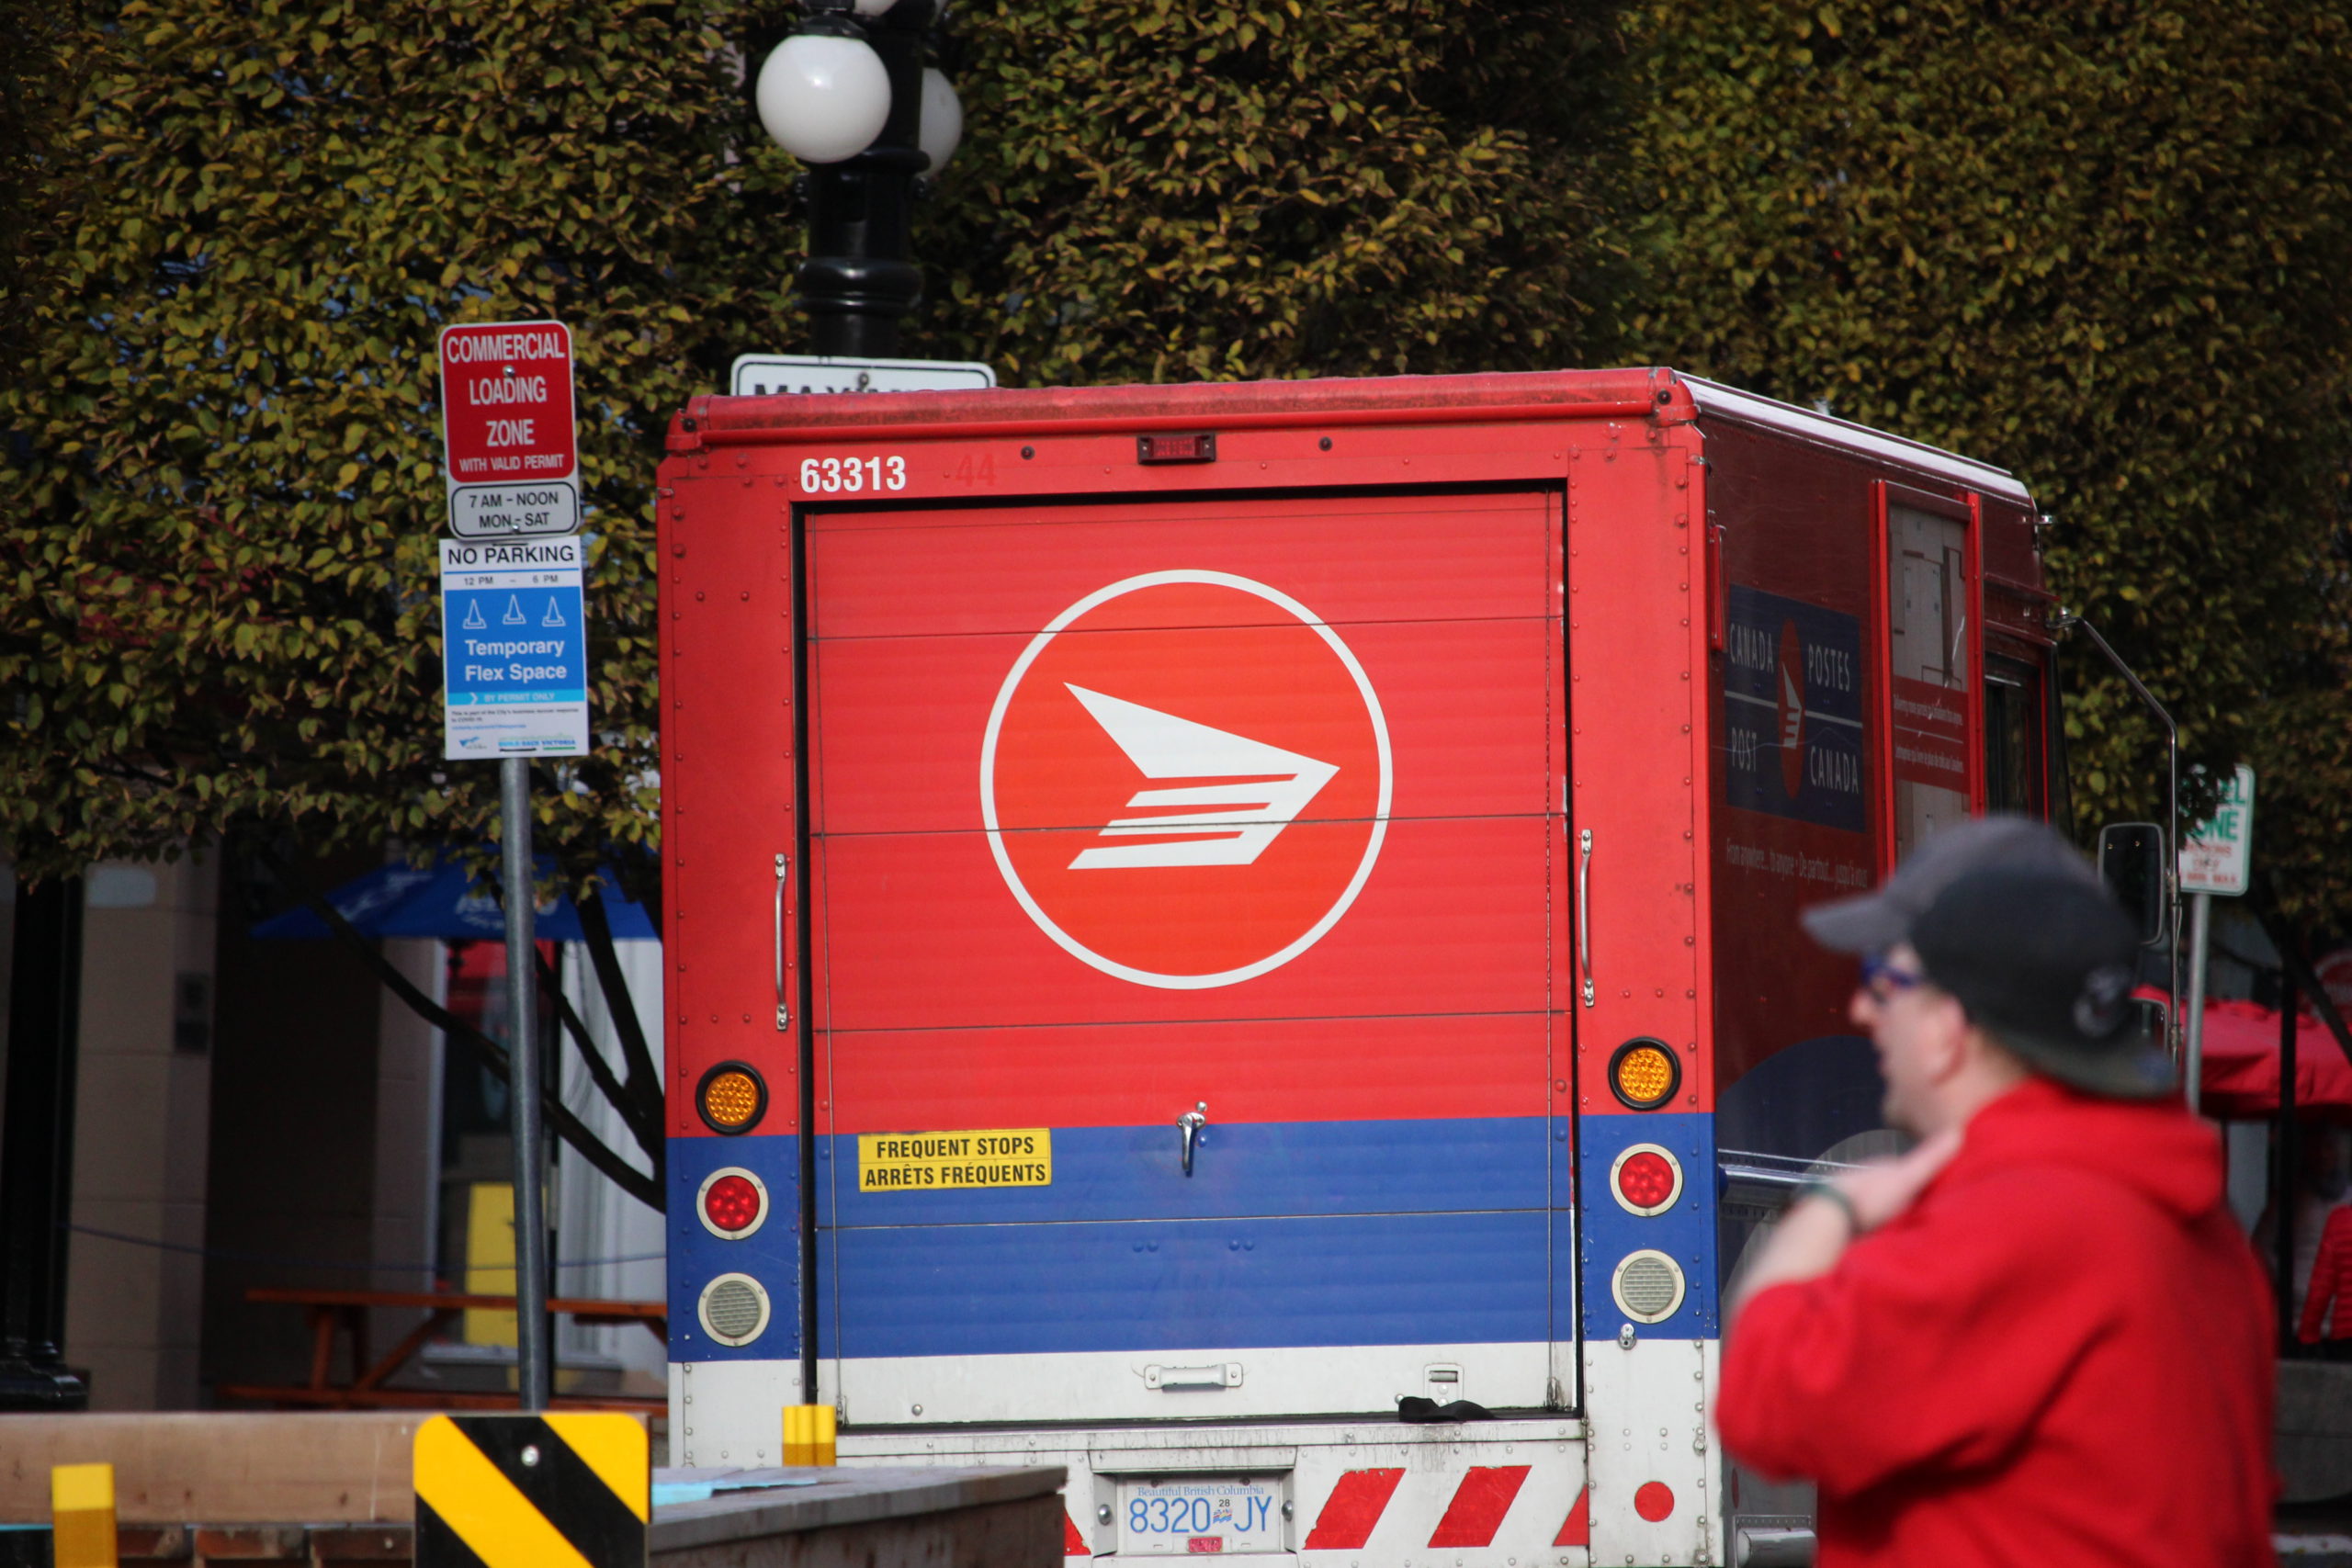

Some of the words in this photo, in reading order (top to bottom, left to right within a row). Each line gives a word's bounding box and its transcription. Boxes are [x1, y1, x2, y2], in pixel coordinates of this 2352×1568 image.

[447, 333, 565, 364] COMMERCIAL
[469, 376, 547, 405] LOADING
[486, 419, 536, 447] ZONE
[459, 457, 488, 472] WITH
[490, 456, 521, 470] VALID
[524, 454, 564, 469] PERMIT
[800, 456, 907, 493] 63313
[469, 494, 478, 508] 7
[481, 494, 503, 507] AM
[516, 491, 559, 506] NOON
[479, 514, 512, 528] MON
[525, 513, 550, 526] SAT
[447, 547, 477, 565] NO
[484, 545, 574, 564] PARKING
[464, 577, 475, 586] 12
[478, 576, 494, 585] PM
[532, 575, 539, 584] 6
[543, 574, 559, 583] PM
[464, 638, 565, 659] Temporary
[1729, 623, 1774, 673] CANADA
[465, 665, 504, 682] Flex
[509, 662, 567, 683] Space
[1808, 644, 1850, 693] POSTES
[1731, 727, 1758, 772] POST
[1810, 746, 1859, 795] CANADA
[876, 1138, 970, 1158] FREQUENT
[977, 1136, 1035, 1156] STOPS
[865, 1164, 934, 1187] ARRÊTS
[941, 1161, 1046, 1185] FRÉQUENTS
[1137, 1485, 1182, 1497] Beautiful
[1183, 1484, 1215, 1496] British
[1216, 1484, 1264, 1496] Columbia
[1218, 1498, 1231, 1507] 28
[1129, 1497, 1211, 1534] 8320
[1234, 1495, 1272, 1532] JY
